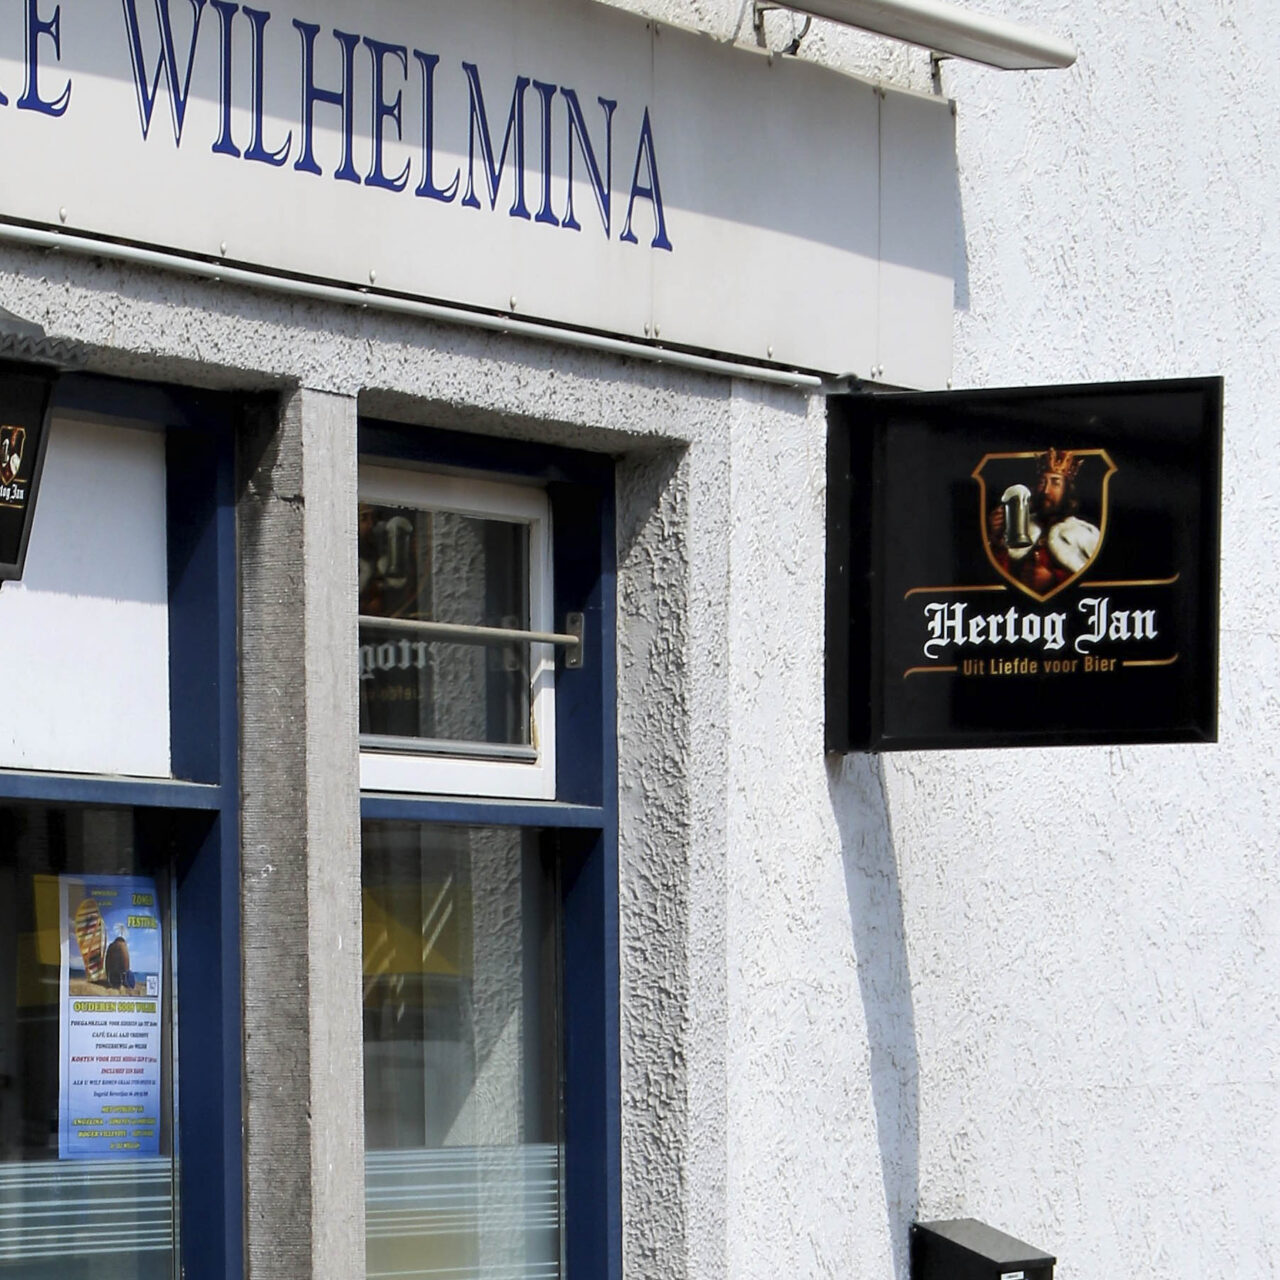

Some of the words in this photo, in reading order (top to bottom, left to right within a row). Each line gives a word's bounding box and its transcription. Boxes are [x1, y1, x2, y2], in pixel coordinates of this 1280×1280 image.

[122, 0, 673, 252] WILHELMINA
[9, 483, 24, 502] Jan
[923, 601, 1066, 659] Hertog
[1074, 597, 1158, 654] Jan
[963, 659, 984, 675] Uit
[990, 657, 1037, 674] Liefde
[1044, 660, 1078, 674] voor
[1084, 655, 1117, 672] Bier
[73, 1002, 116, 1012] OUDEREN
